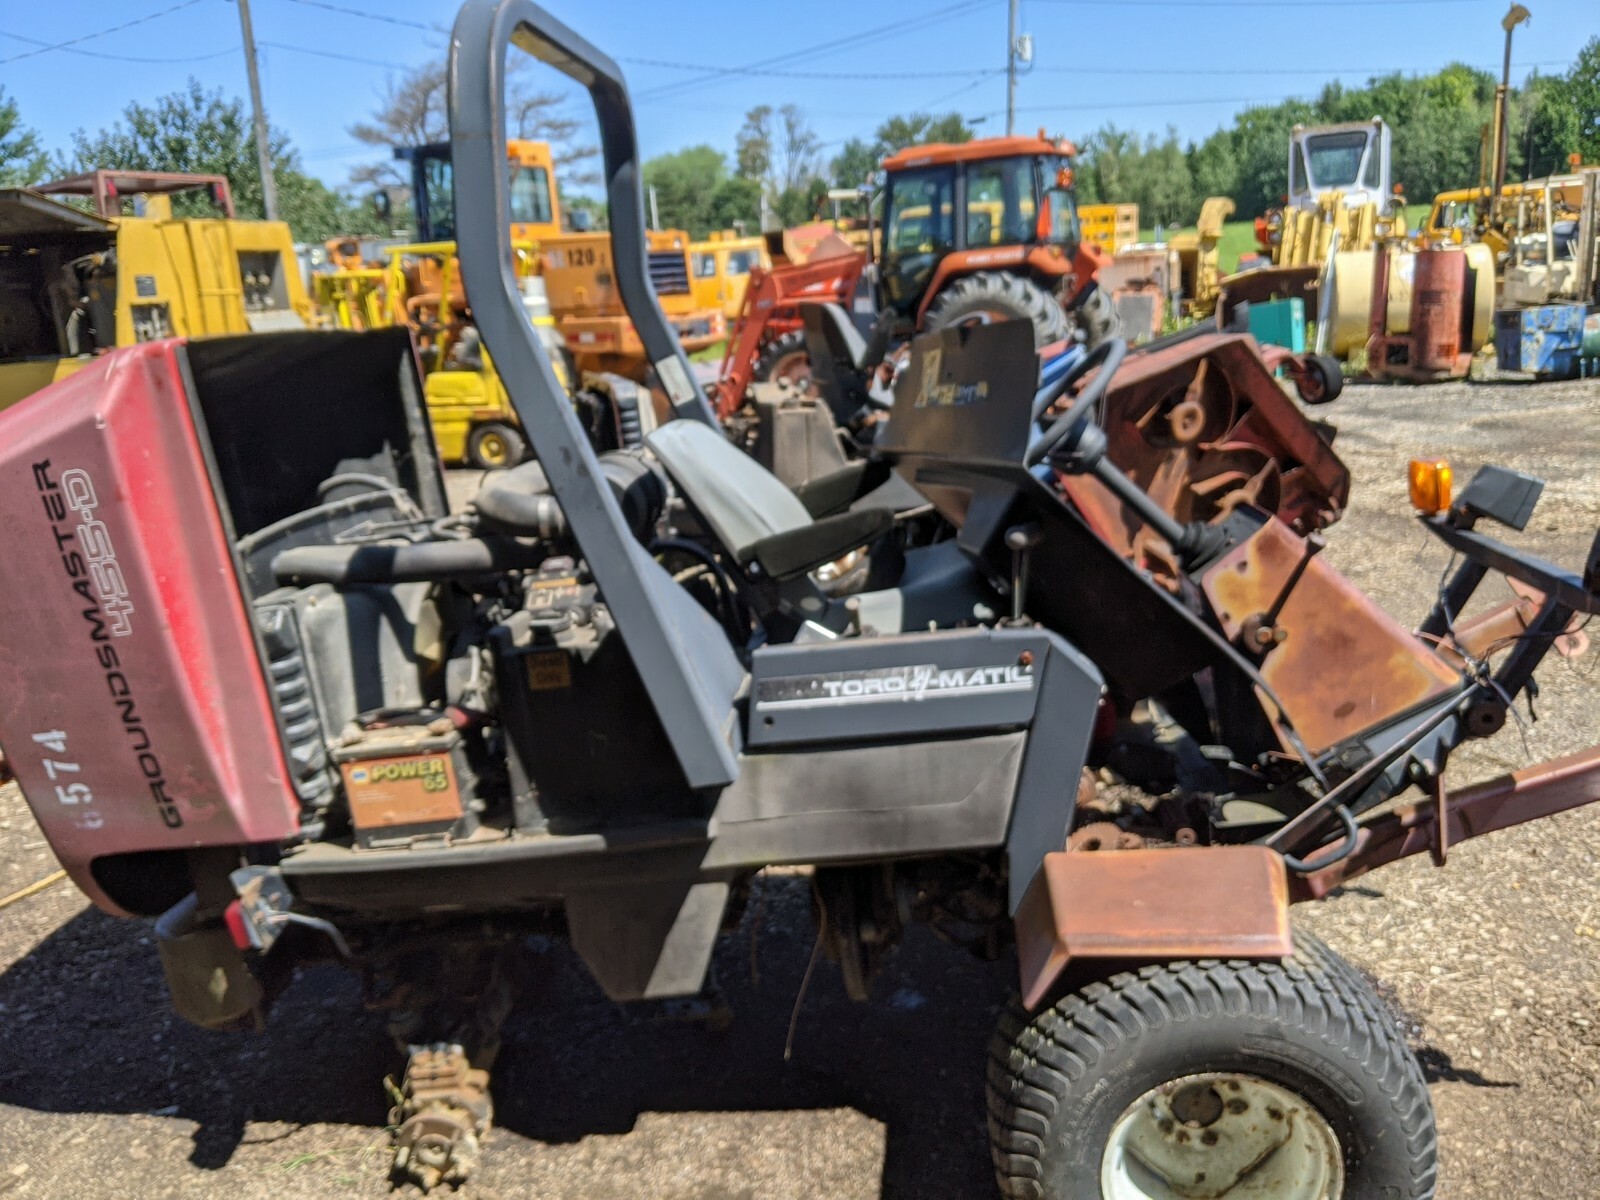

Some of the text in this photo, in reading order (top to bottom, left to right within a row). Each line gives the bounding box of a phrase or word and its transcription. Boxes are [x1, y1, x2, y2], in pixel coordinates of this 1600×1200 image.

[568, 248, 595, 267] 120
[61, 468, 135, 637] 455-D
[32, 458, 183, 829] GROUNDSMASTER
[371, 759, 445, 782] POWER
[423, 774, 449, 792] 65
